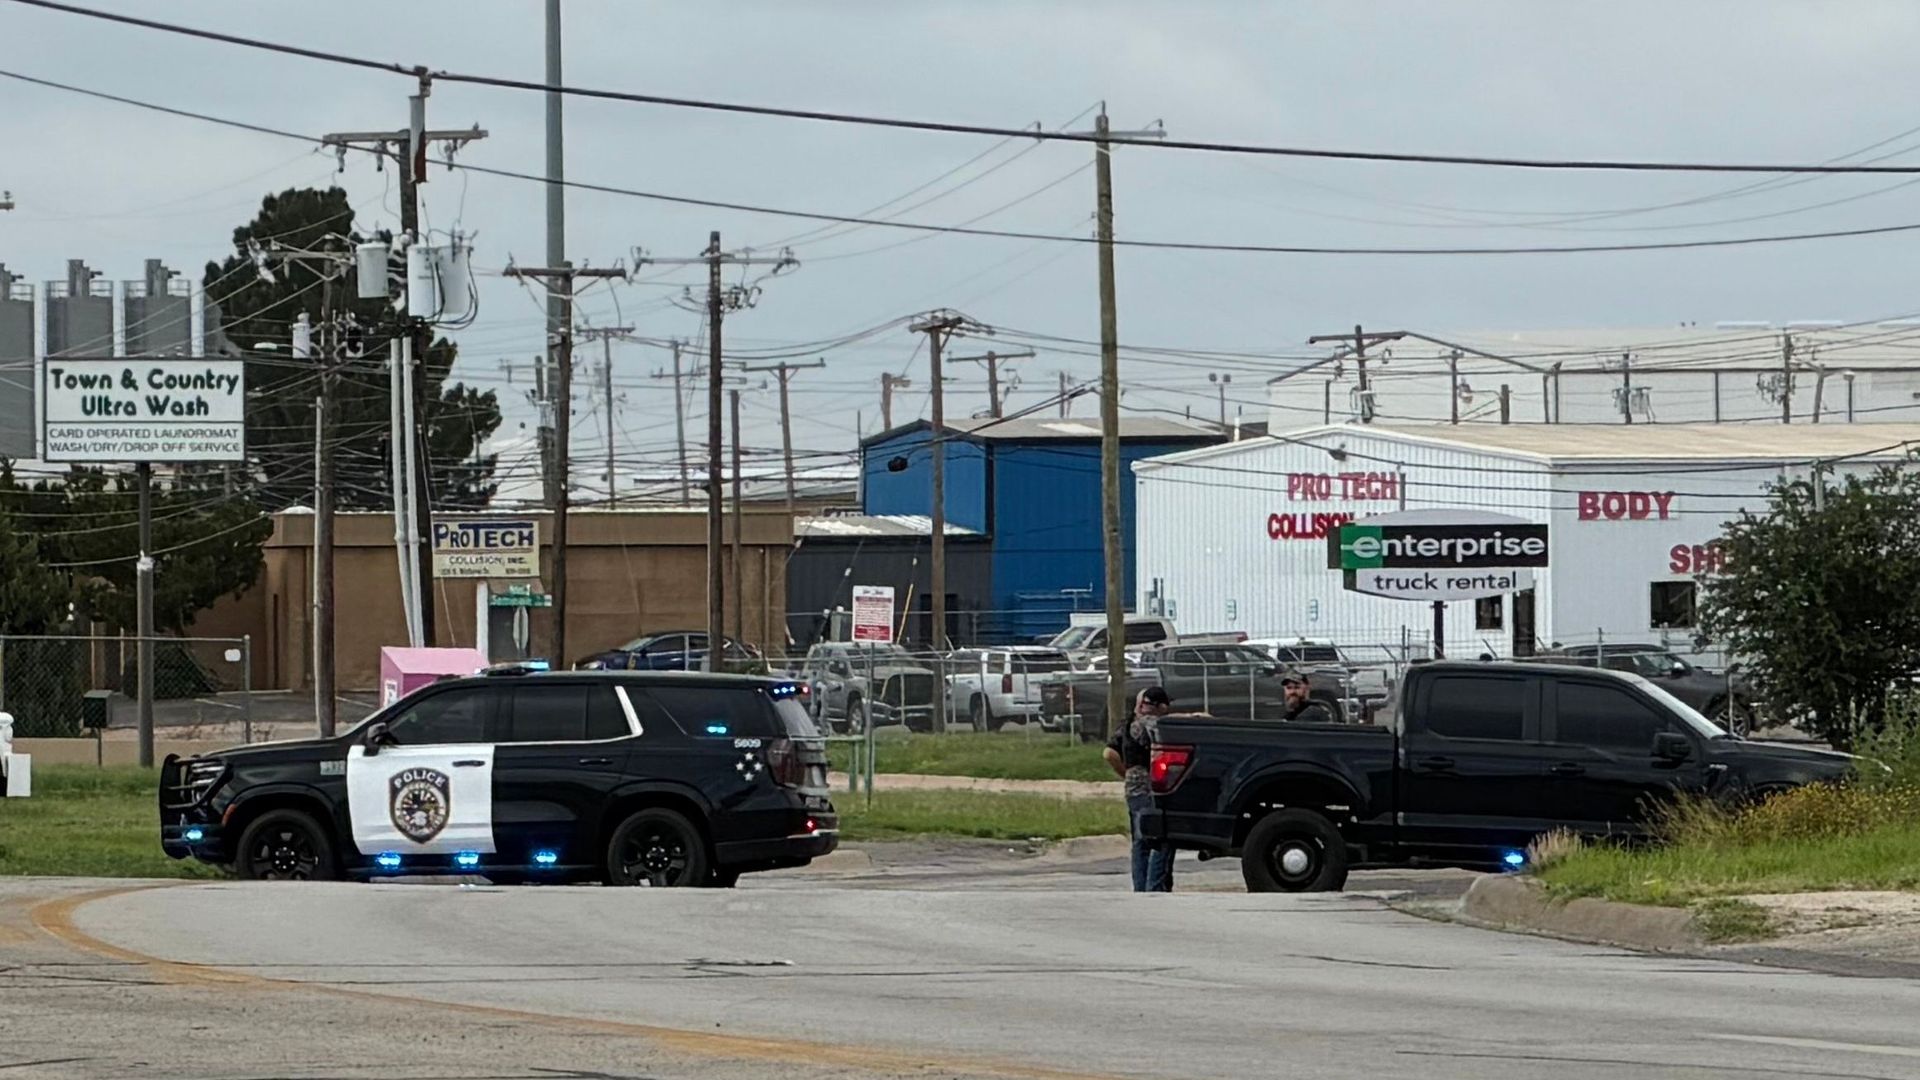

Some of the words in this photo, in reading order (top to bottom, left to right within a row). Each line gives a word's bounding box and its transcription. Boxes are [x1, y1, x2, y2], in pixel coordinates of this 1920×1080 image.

[51, 368, 112, 390] Town
[121, 368, 139, 391] &
[147, 368, 239, 395] Country
[81, 395, 137, 416] Ultra
[146, 395, 209, 416] Wash
[50, 428, 84, 438] CARD
[87, 428, 150, 438] OPERATED
[154, 428, 238, 438] LAUNDROMAT
[50, 443, 158, 453] WASH/DRY/DROP
[161, 443, 186, 453] OFF
[189, 442, 240, 453] SERVICE
[1288, 473, 1331, 500] PRO
[1338, 472, 1397, 500] TECH
[1579, 491, 1675, 520] BODY
[1352, 531, 1546, 563] enterprise
[1374, 573, 1438, 591] truck
[1446, 571, 1517, 590] rental
[394, 769, 446, 789] POLICE
